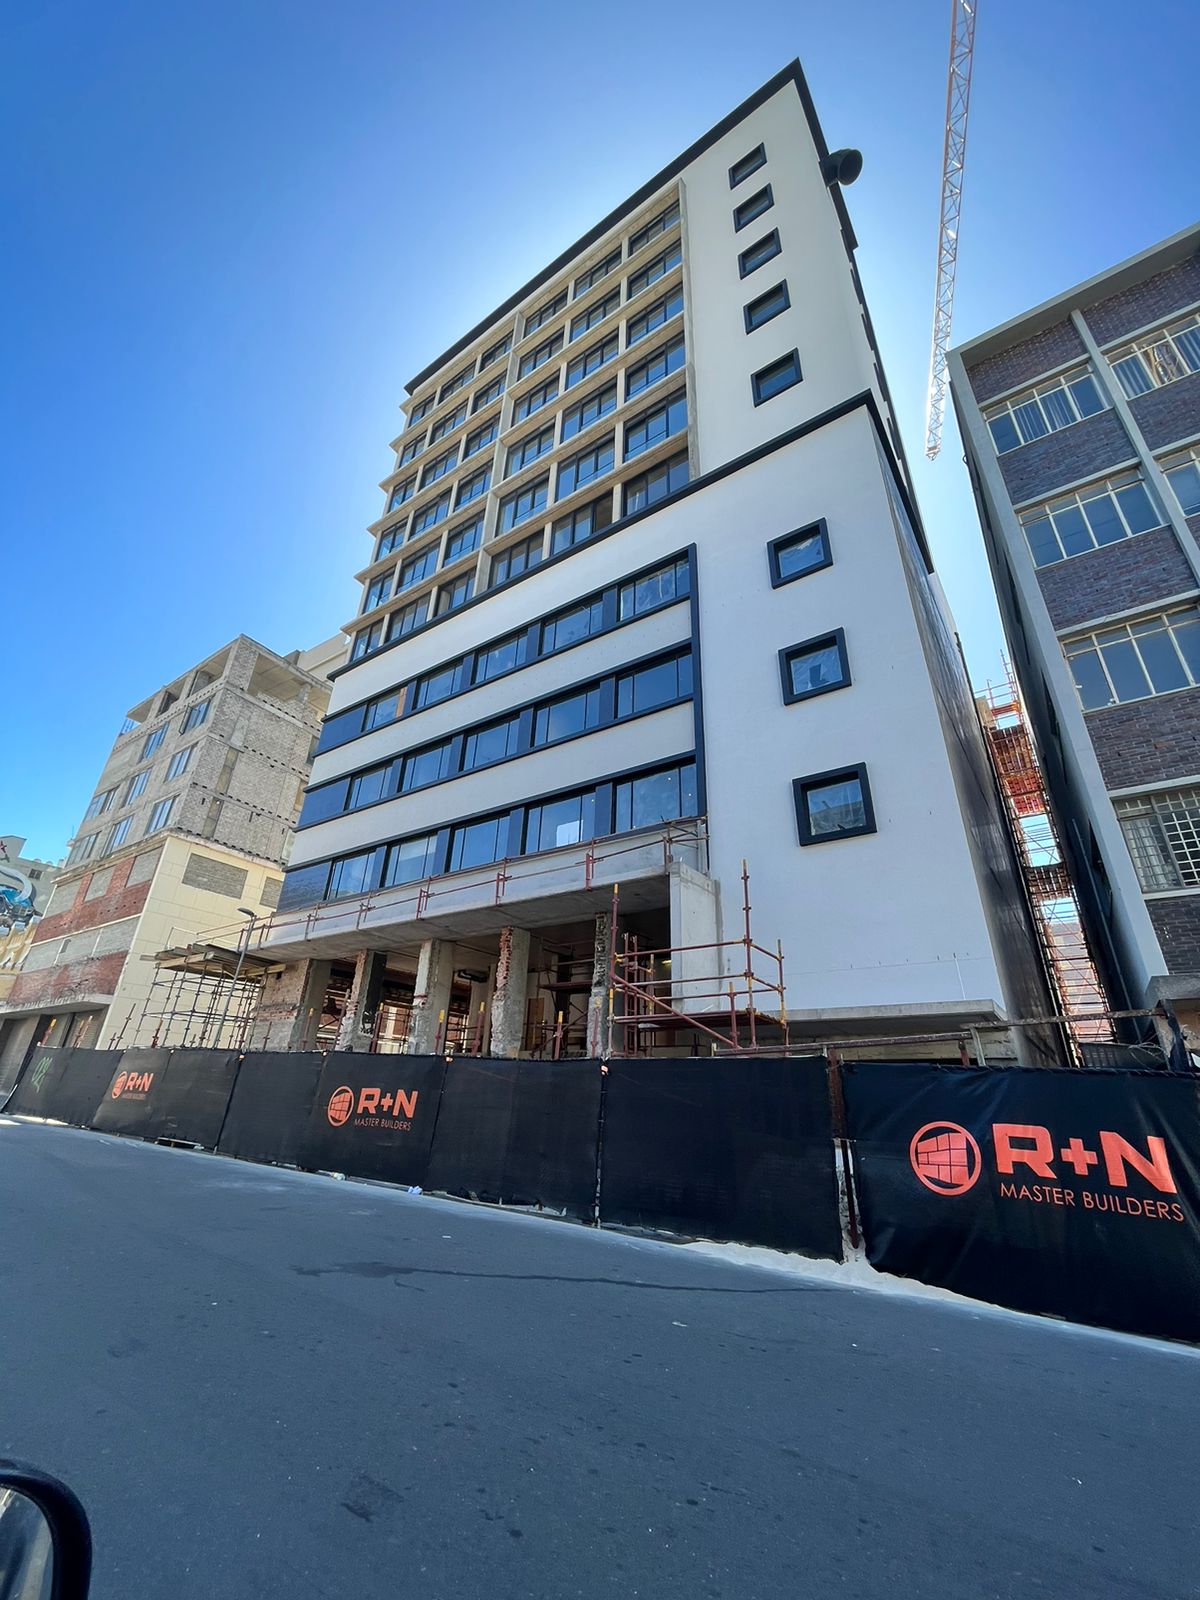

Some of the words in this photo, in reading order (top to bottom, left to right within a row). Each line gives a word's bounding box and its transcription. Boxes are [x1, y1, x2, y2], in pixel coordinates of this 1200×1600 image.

[125, 1072, 153, 1091] R+N
[357, 1087, 418, 1118] R+N
[354, 1118, 379, 1127] MASTER
[381, 1119, 411, 1131] BUILDERS
[992, 1123, 1178, 1194] R+N
[1000, 1182, 1075, 1206] MASTER
[1081, 1191, 1185, 1222] BUILDERS
